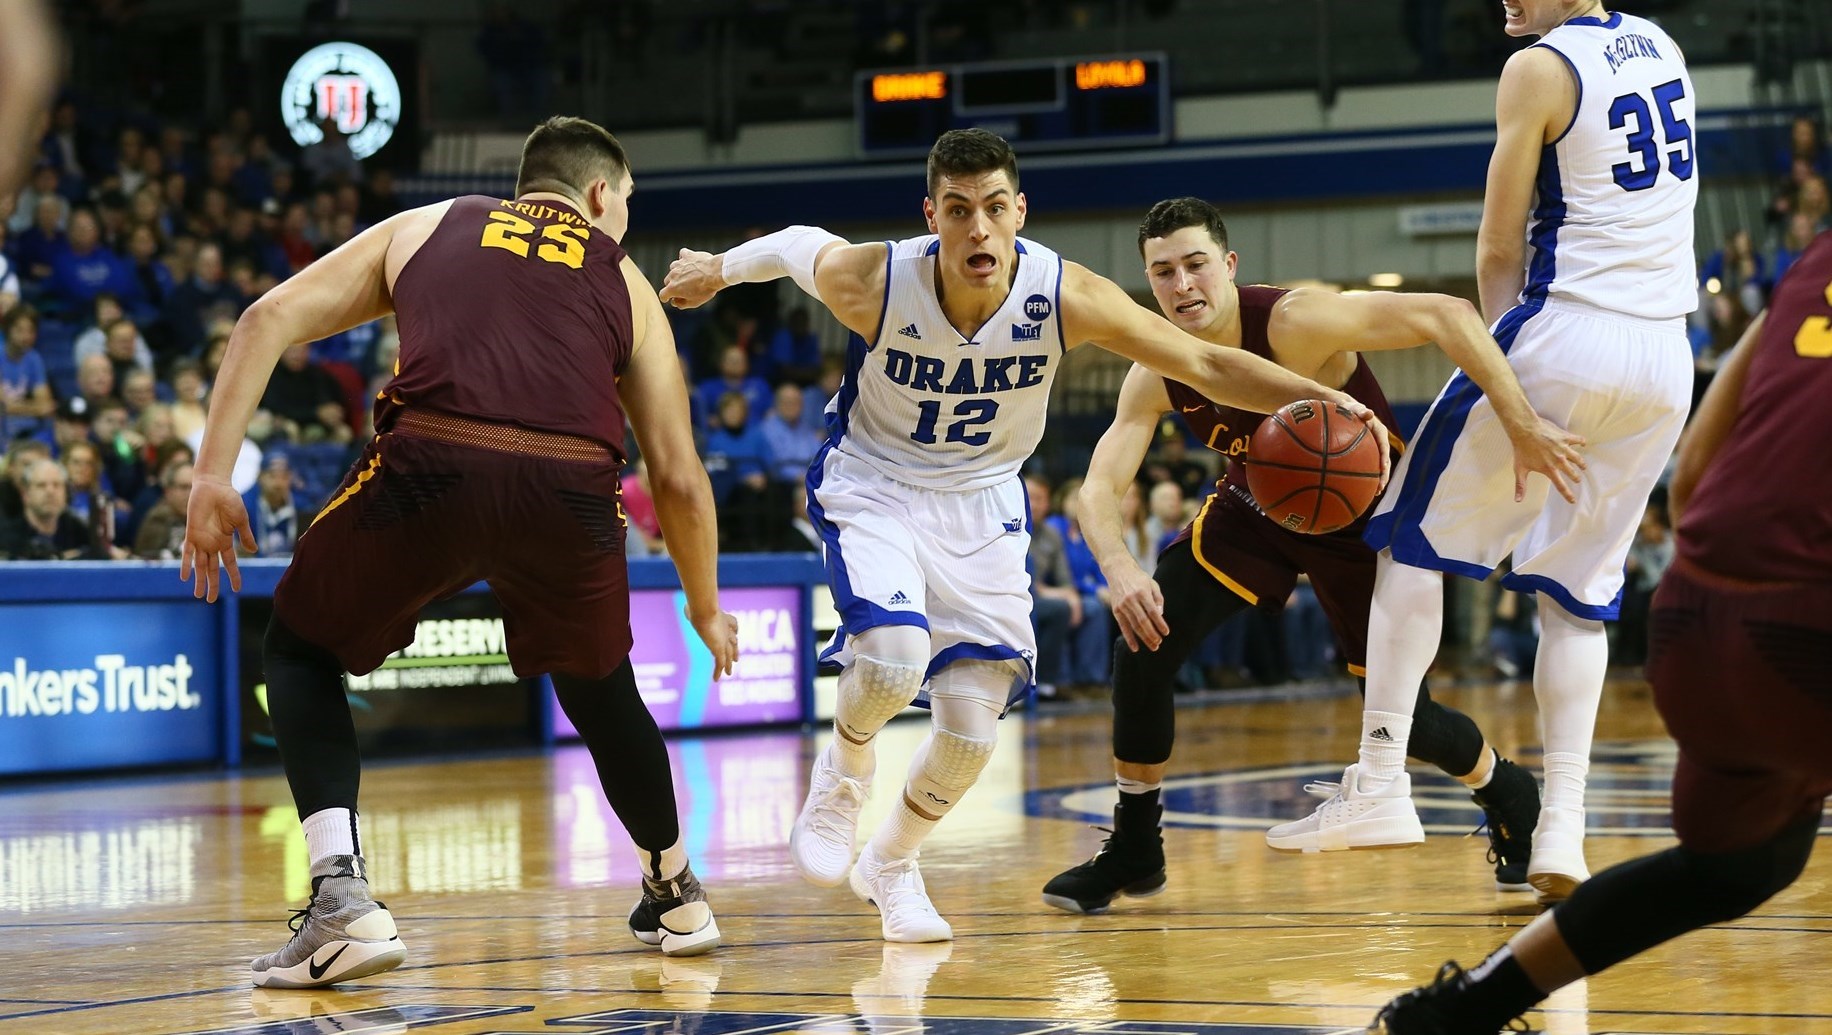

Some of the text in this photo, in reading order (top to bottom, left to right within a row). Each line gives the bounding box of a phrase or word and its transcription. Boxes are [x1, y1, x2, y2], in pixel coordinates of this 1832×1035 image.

[1608, 78, 1694, 192] 35
[481, 210, 590, 269] 25
[1026, 301, 1049, 314] PFM
[884, 347, 1048, 395] DRAKE
[910, 398, 1000, 447] 12
[723, 609, 796, 653] MCA
